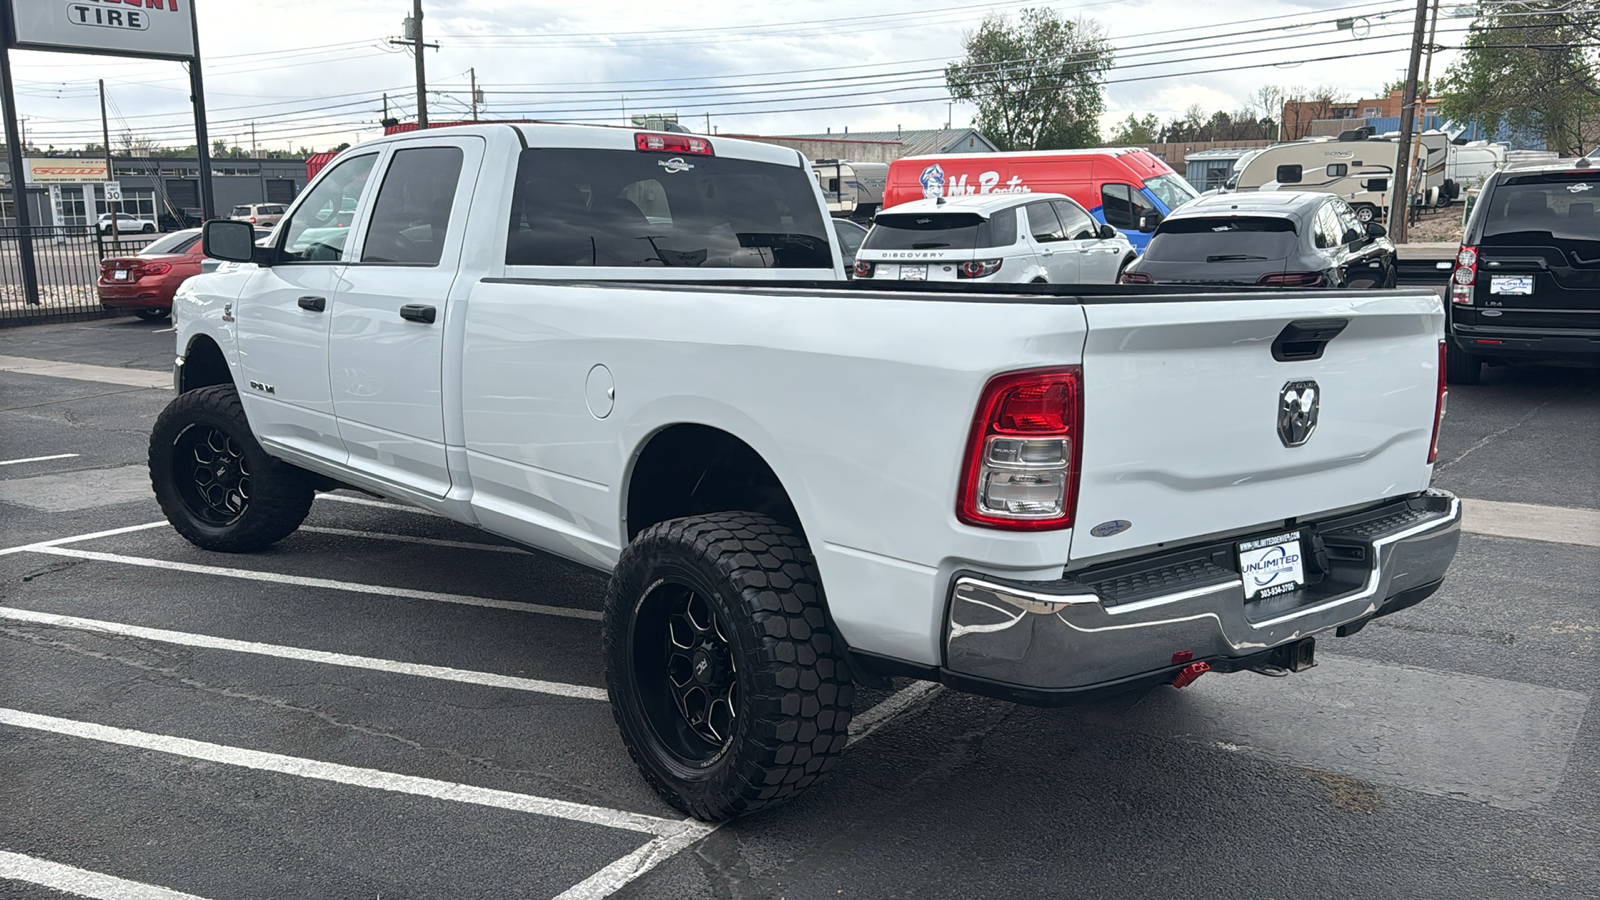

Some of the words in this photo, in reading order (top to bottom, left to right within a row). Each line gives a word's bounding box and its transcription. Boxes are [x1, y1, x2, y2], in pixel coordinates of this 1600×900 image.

[75, 6, 142, 28] TIRE
[107, 191, 120, 200] 30
[1241, 554, 1299, 574] UNLIMITED
[1260, 582, 1295, 599] 303-934-3705
